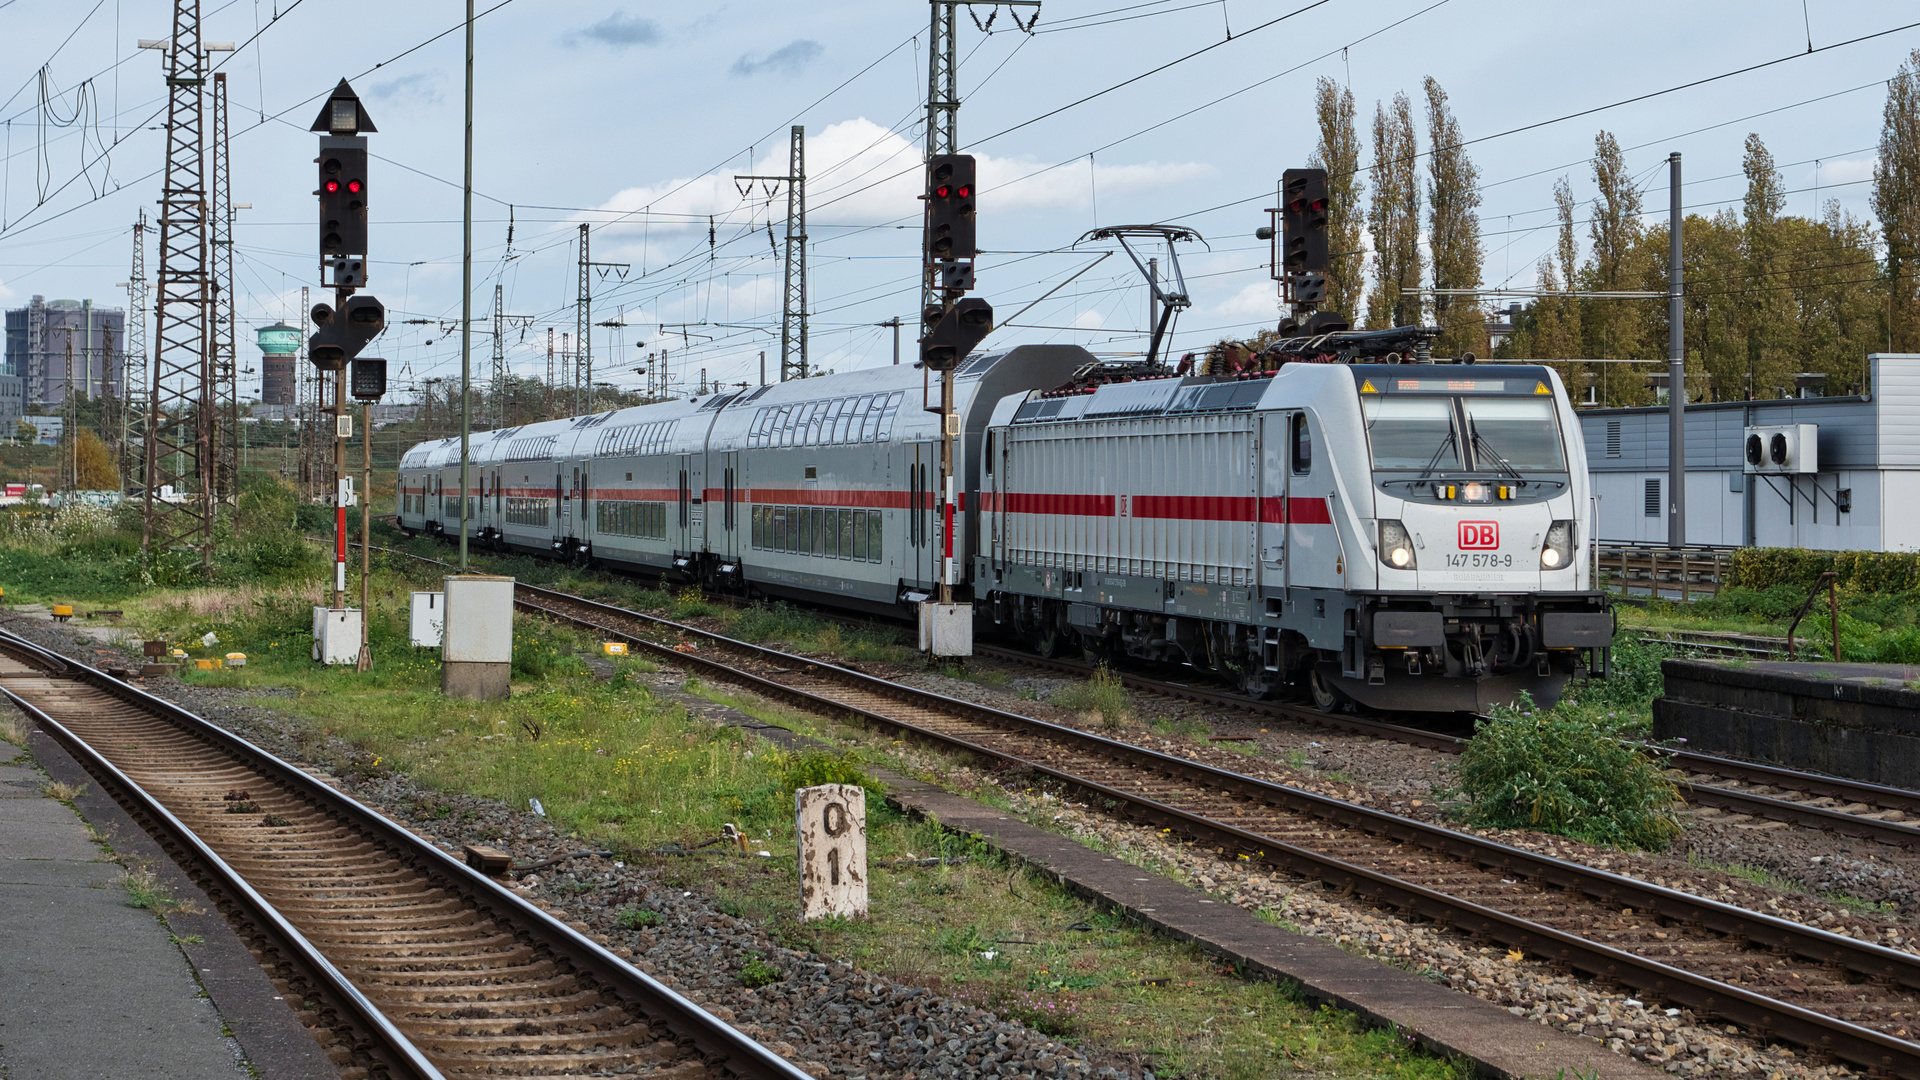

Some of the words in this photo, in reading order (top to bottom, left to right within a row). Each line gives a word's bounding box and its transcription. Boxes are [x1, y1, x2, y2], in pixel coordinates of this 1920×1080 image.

[1463, 525, 1495, 546] DB
[1446, 554, 1468, 567] 147
[1473, 554, 1512, 567] 578-9
[823, 802, 847, 838] 0
[827, 847, 839, 885] 1
